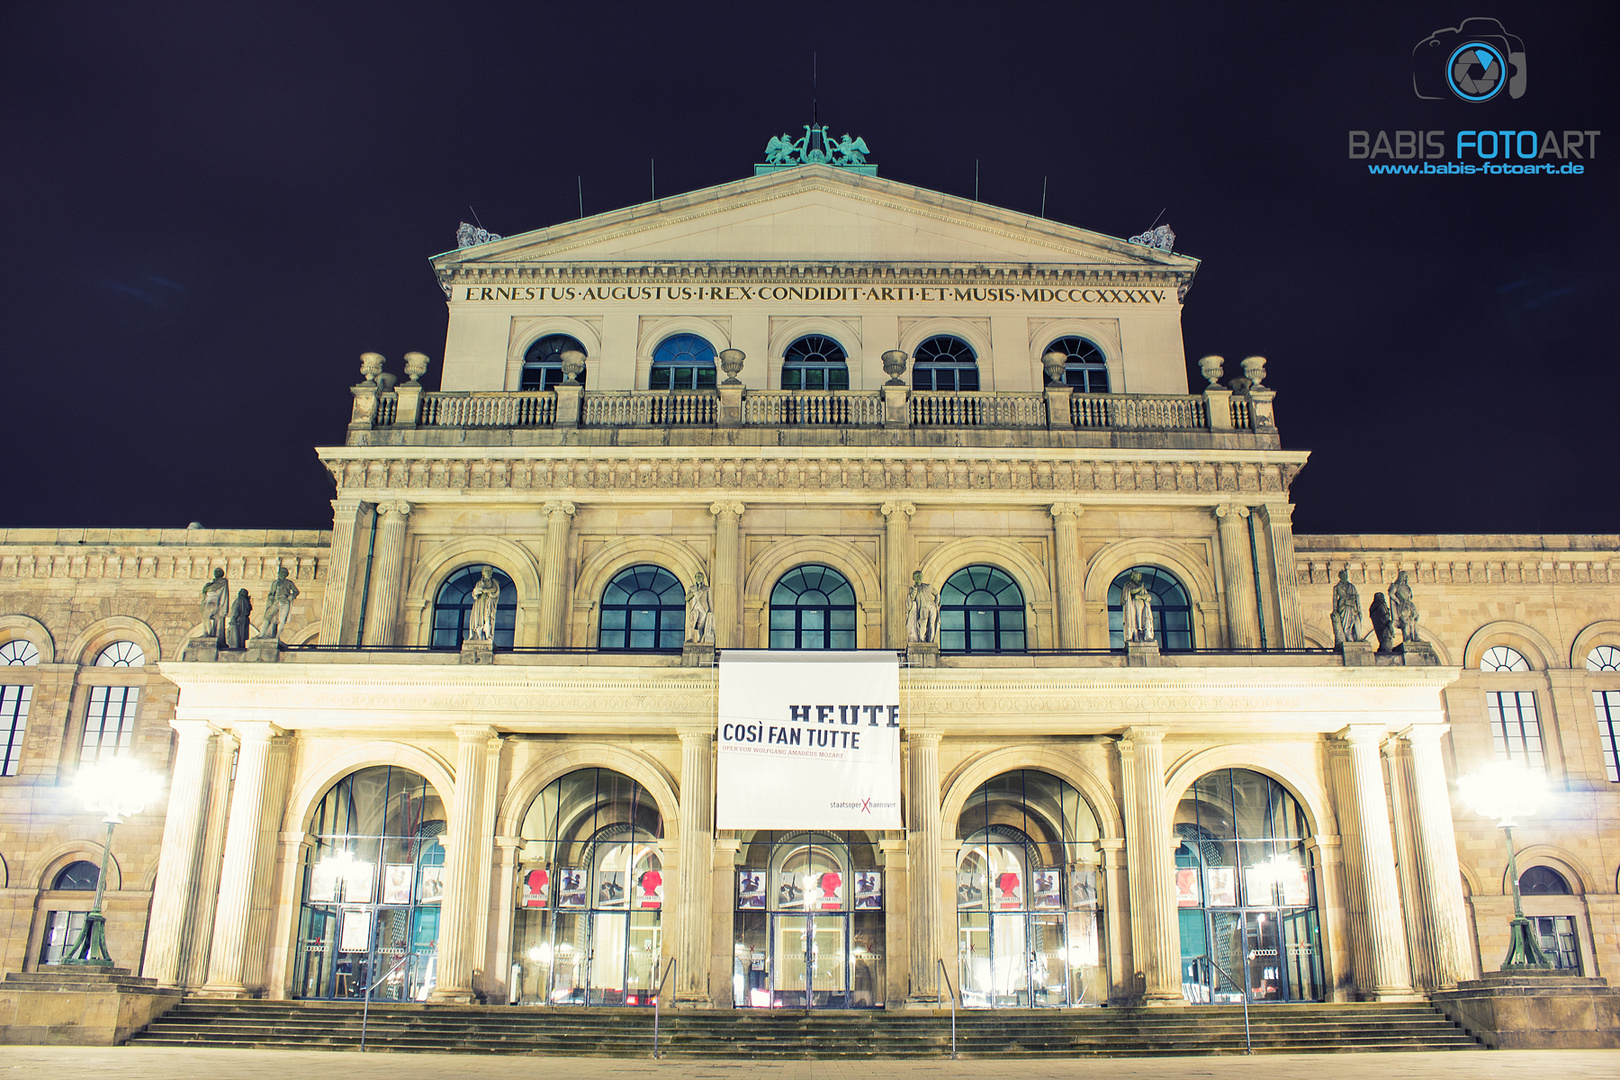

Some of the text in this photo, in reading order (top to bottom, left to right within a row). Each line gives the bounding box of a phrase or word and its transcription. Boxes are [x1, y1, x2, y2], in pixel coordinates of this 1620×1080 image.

[465, 287, 576, 301] ERNESTUS
[582, 286, 692, 300] AUGUSTUS
[710, 286, 753, 300] REX
[758, 286, 863, 300] CONDIDIT
[866, 286, 915, 301] ARTI
[921, 287, 949, 301] ET
[954, 287, 1015, 302] MUSIS
[789, 705, 900, 728] HEUTE
[768, 726, 801, 746] FAN
[807, 728, 861, 750] TUTTE
[753, 747, 787, 755] WOLFGANG
[787, 749, 818, 757] AMADEUS
[819, 751, 844, 759] MOZART
